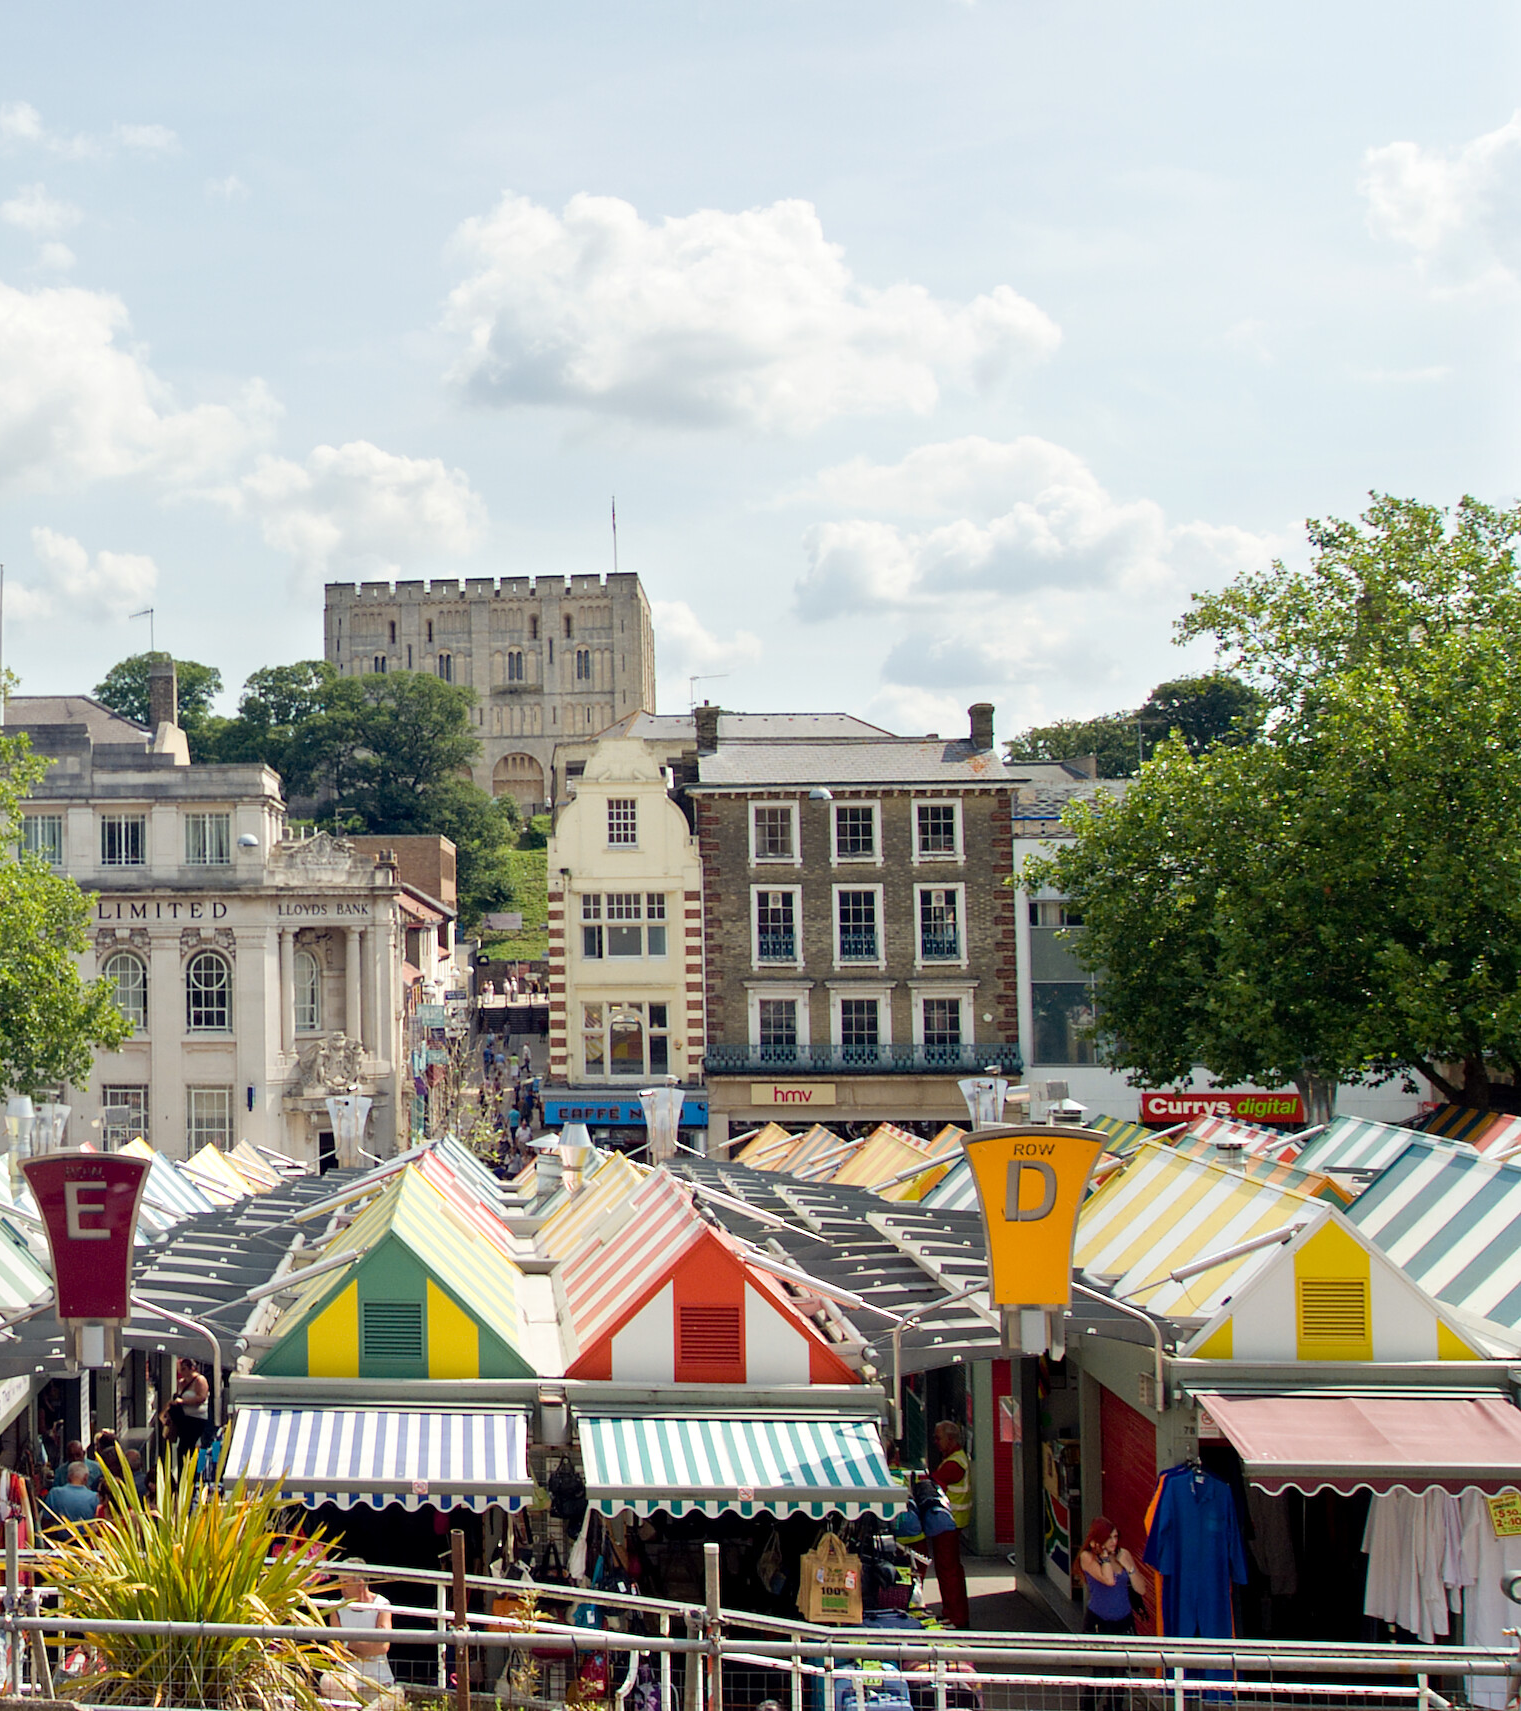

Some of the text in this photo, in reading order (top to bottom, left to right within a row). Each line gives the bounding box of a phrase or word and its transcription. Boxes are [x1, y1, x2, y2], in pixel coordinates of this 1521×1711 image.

[98, 902, 227, 919] LIMITED
[278, 903, 369, 916] LLOYDS BANK
[774, 1086, 812, 1102] hmv
[558, 1105, 620, 1120] CAFFÉ
[1148, 1097, 1297, 1118] Currys.digital
[1013, 1143, 1055, 1156] ROW
[1005, 1160, 1057, 1222] D
[64, 1181, 111, 1240] E
